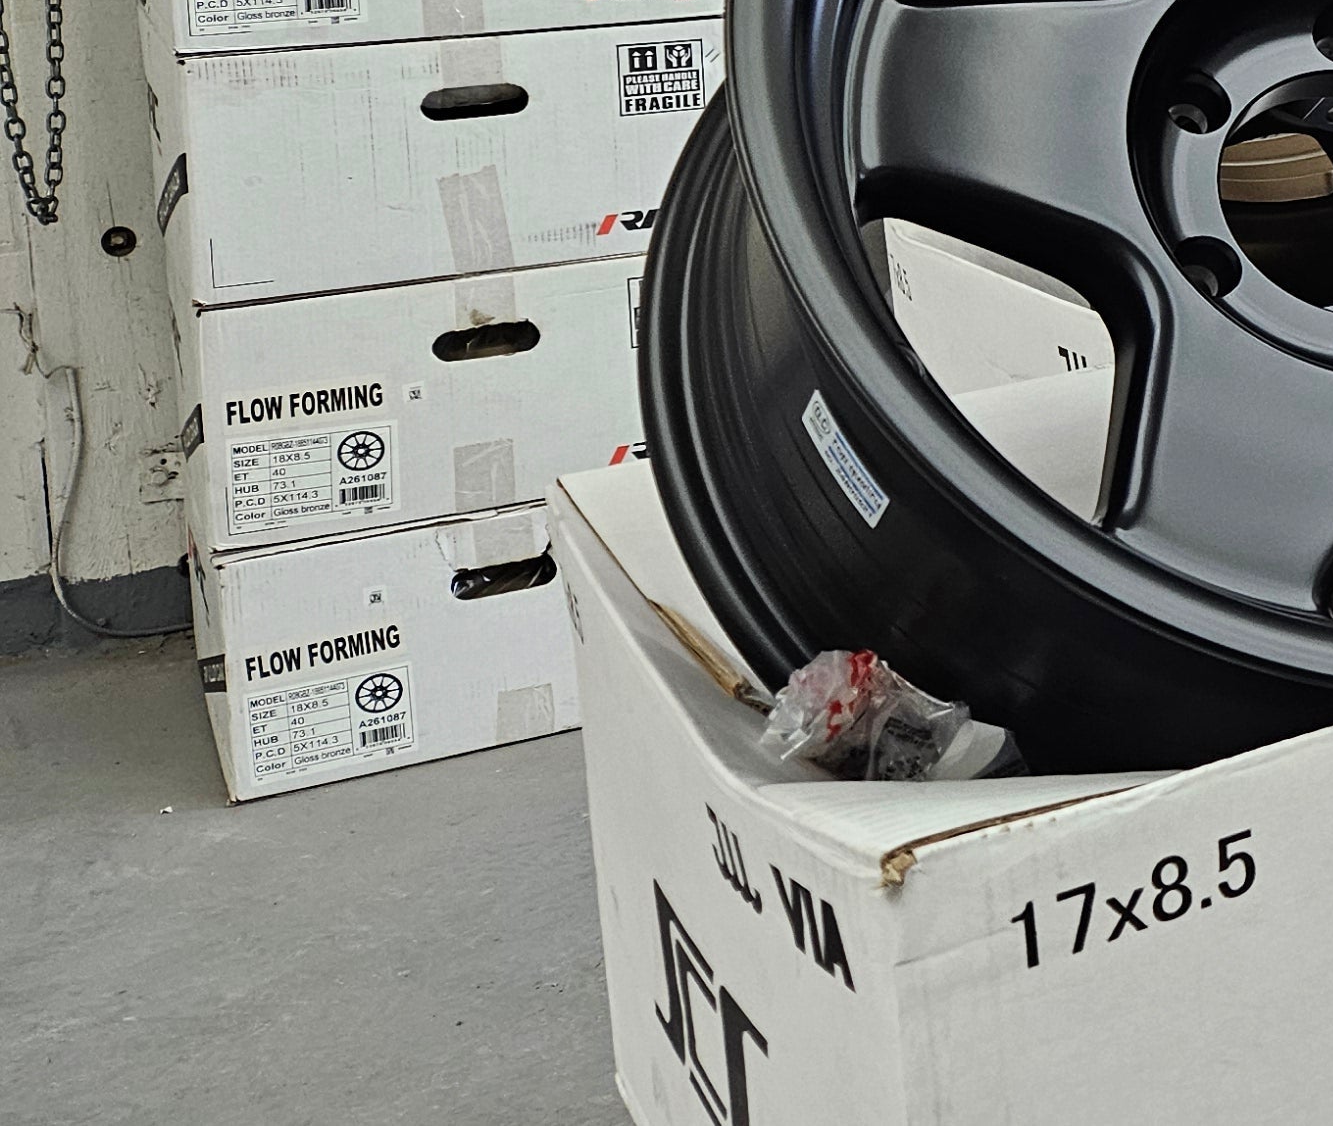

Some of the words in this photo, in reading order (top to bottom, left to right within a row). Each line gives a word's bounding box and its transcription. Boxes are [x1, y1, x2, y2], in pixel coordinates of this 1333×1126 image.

[196, 0, 229, 10] P.C.D
[197, 14, 230, 24] Color
[236, 11, 263, 21] Gloss
[265, 8, 296, 18] bronze
[626, 75, 661, 85] PLEASE
[662, 72, 698, 82] HANDLE
[626, 83, 662, 95] WITH
[663, 80, 698, 92] CARE
[625, 93, 701, 113] FRAGILE
[226, 395, 283, 426] FLOW
[289, 383, 383, 417] FORMING
[232, 443, 268, 456] MODEL
[233, 458, 260, 468] SIZE
[272, 451, 311, 464] 18X8.5
[234, 472, 249, 482] ET
[272, 467, 286, 477] 40
[339, 472, 388, 486] A261087
[234, 484, 260, 495] HUB
[272, 480, 297, 491] 73.1
[235, 497, 266, 508] P.C.D
[273, 490, 319, 504] 5X114.3
[235, 510, 266, 521] Color
[273, 506, 299, 518] Gloss
[301, 502, 330, 513] bronze
[245, 647, 301, 682] FLOW
[307, 624, 401, 667] FORMING
[250, 694, 285, 709] MODEL
[251, 709, 278, 722] SIZE
[290, 698, 329, 713] 18X8.5
[252, 724, 268, 735] ET
[290, 716, 305, 726] 40
[358, 711, 407, 729] A261087
[253, 735, 279, 748] HUB
[292, 728, 316, 739] 73.1
[255, 747, 286, 760] P.C.D
[293, 735, 339, 753] 5X114.3
[256, 760, 286, 774] Color
[293, 754, 320, 766] Gloss
[321, 746, 351, 761] bronze
[1010, 829, 1257, 969] 17x8.5
